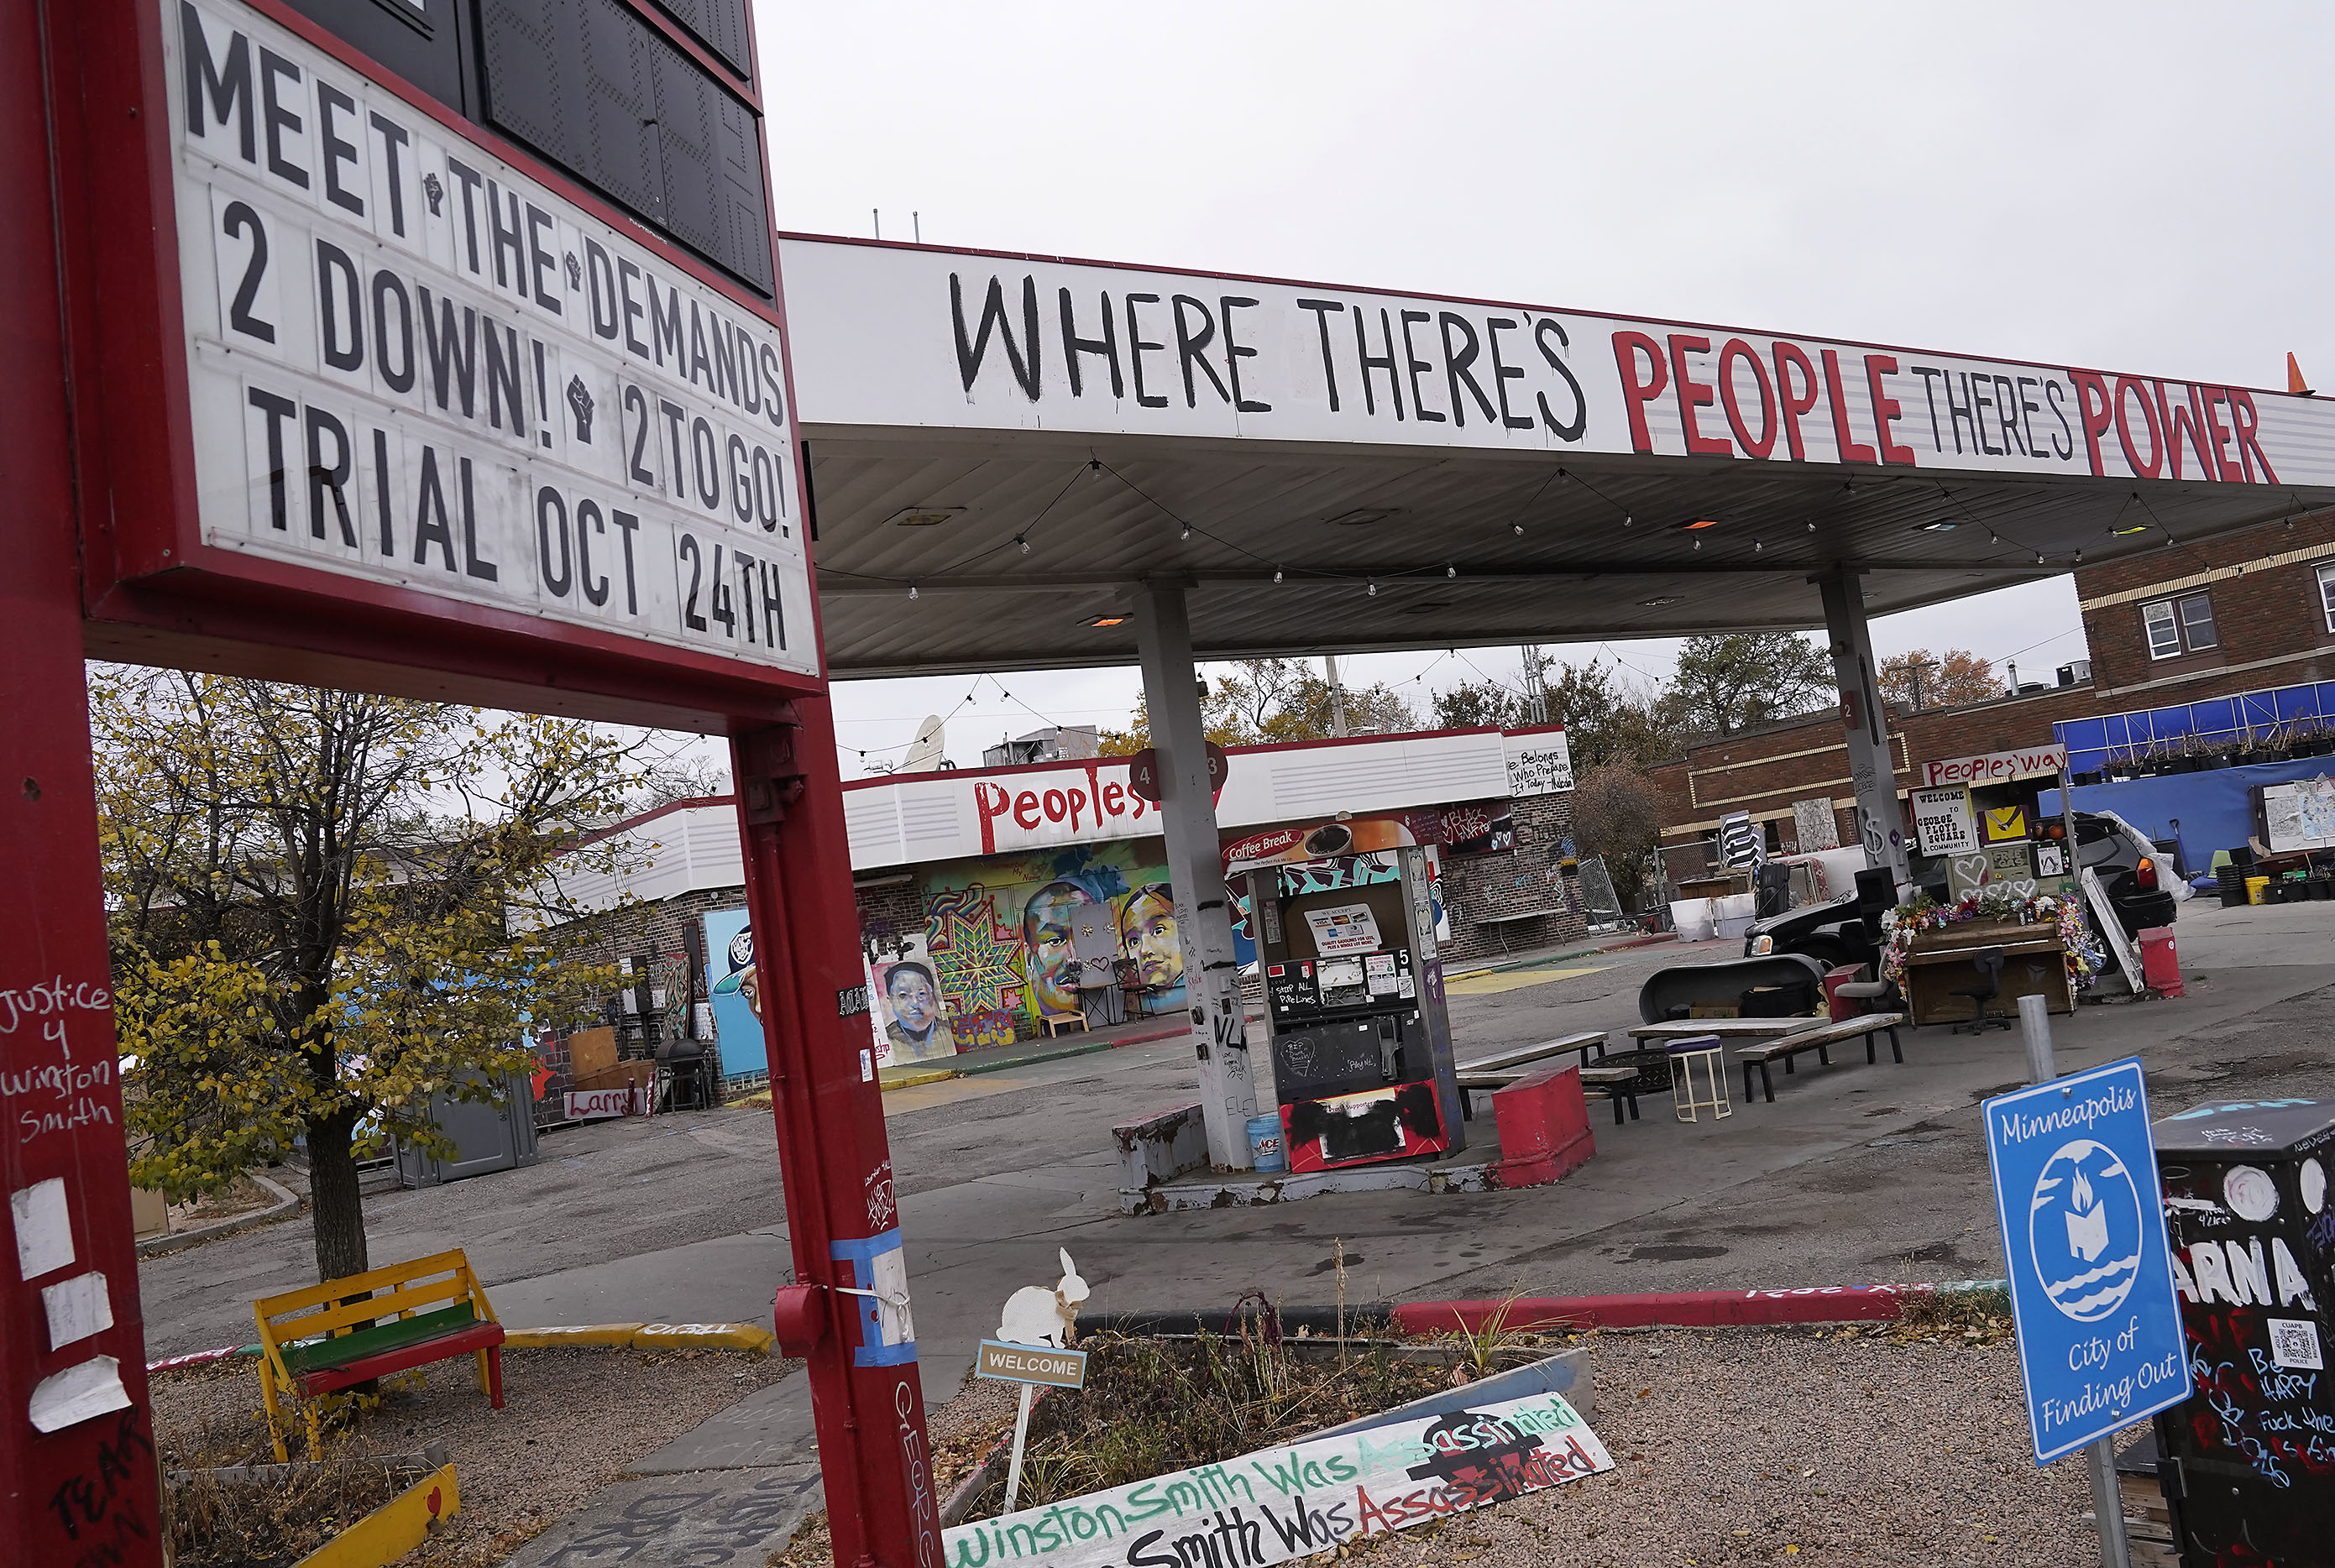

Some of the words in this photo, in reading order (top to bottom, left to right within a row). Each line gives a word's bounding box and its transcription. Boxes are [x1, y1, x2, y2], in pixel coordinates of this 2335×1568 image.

[181, 1, 409, 238] MEET
[448, 156, 562, 316] THE
[585, 237, 785, 429] DEMANDS
[223, 201, 275, 344] 2
[317, 238, 553, 450] DOWN!
[729, 435, 789, 539] GO!
[949, 272, 1272, 413] WHERE
[1297, 297, 1588, 443] THERE'S
[1611, 330, 1916, 468] PEOPLE
[1910, 365, 2074, 462] THERE'S
[2068, 368, 2281, 485] POWER
[249, 385, 498, 583] TRIAL
[537, 485, 640, 617] OCT
[679, 533, 787, 652] 24TH
[1207, 758, 1217, 775] 3
[1521, 750, 1559, 766] Belongs
[1139, 766, 1151, 784] 4
[1513, 767, 1535, 782] Who
[1536, 763, 1569, 779] Prepare
[1512, 782, 1524, 796] It
[1526, 778, 1545, 794] Today
[1919, 791, 1965, 804] WELCOME
[974, 766, 1145, 855] Peoples
[1917, 813, 1953, 826] GEORGE
[1925, 822, 1957, 835] FLOYD
[1928, 830, 1966, 844] SQUARE
[1229, 842, 1260, 860] Coffee
[1263, 831, 1292, 850] Break
[1929, 841, 1970, 852] COMMUNITY
[1400, 949, 1409, 964] 5
[1298, 982, 1313, 991] ALL
[0, 975, 111, 1033] Justice
[571, 1090, 638, 1119] Larry
[2001, 1085, 2136, 1146] Minneapolis
[20, 1097, 113, 1143] Smith
[1258, 1137, 1280, 1148] ACE
[2069, 1339, 2111, 1372] City
[2118, 1315, 2139, 1351] of
[2309, 1333, 2318, 1358] BRUTALITY
[988, 1351, 1078, 1377] WELCOME
[2041, 1378, 2134, 1433] Finding
[2138, 1352, 2177, 1388] Out
[2259, 1372, 2317, 1402] HAPPY
[1126, 1465, 1255, 1522] Smith
[1251, 1451, 1358, 1495] Was
[1127, 1505, 1266, 1568] Smith
[1260, 1495, 1354, 1554] Was
[1357, 1435, 1597, 1534] Assassinated
